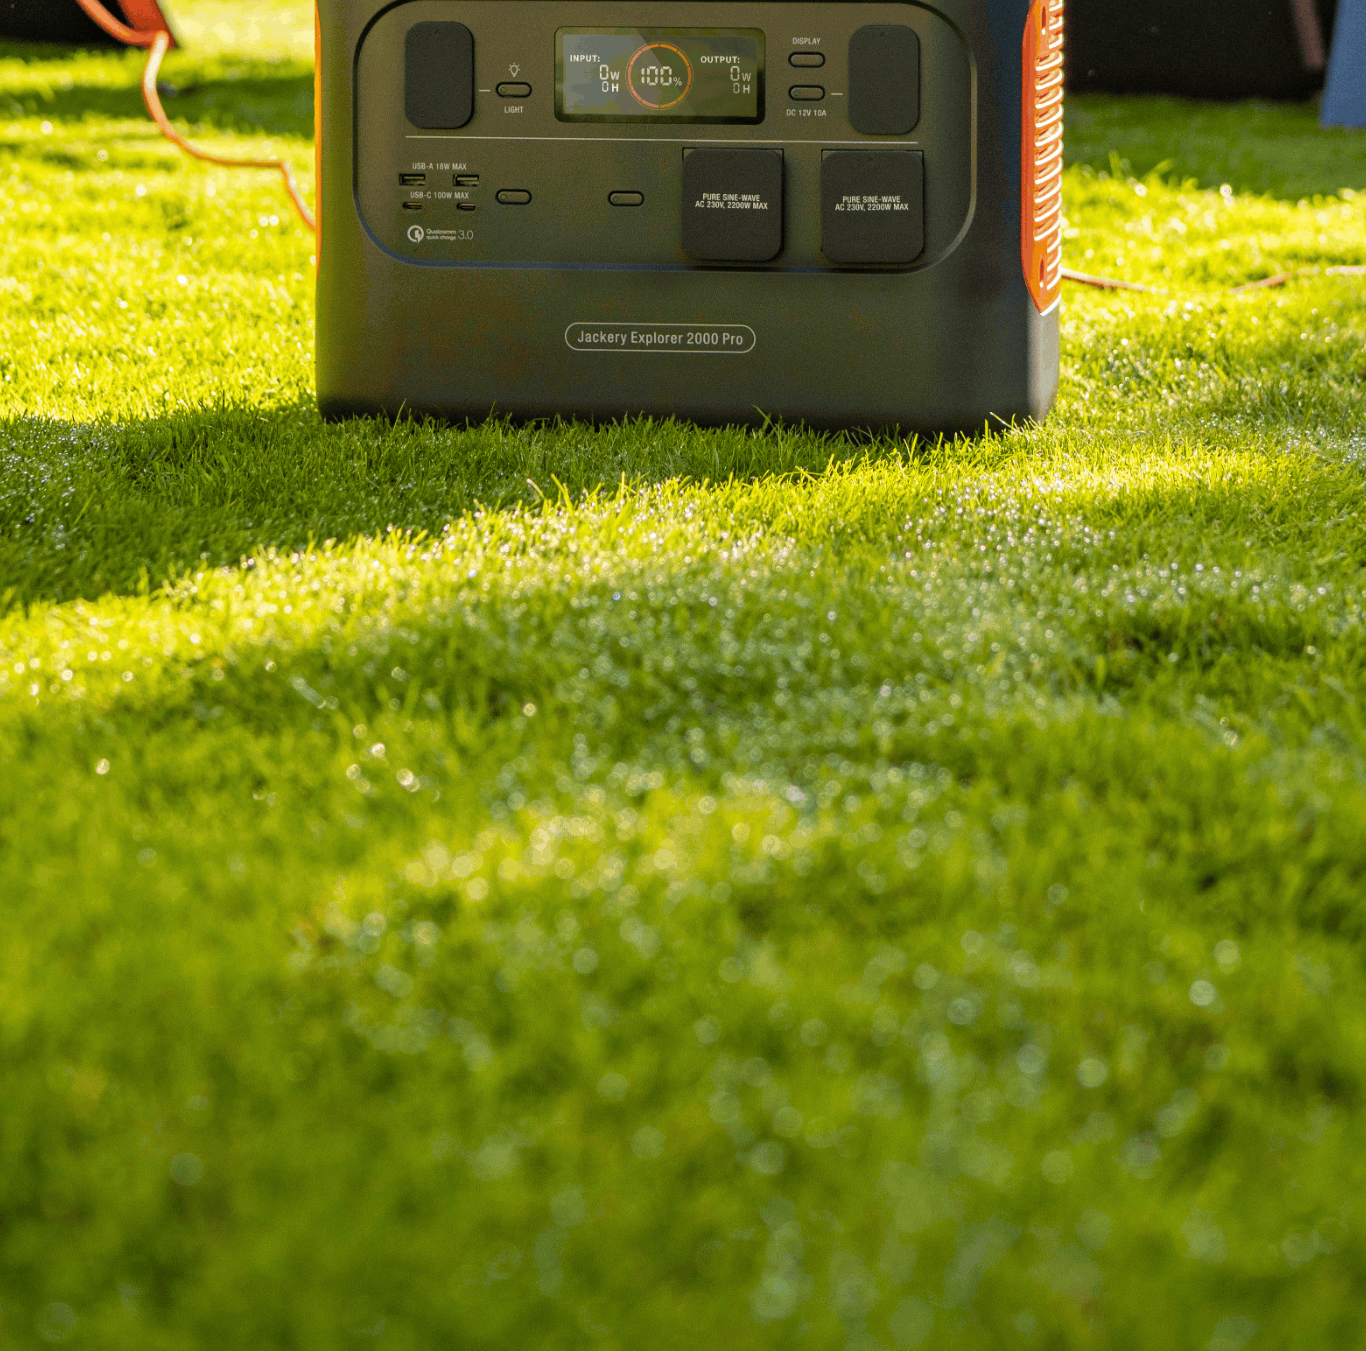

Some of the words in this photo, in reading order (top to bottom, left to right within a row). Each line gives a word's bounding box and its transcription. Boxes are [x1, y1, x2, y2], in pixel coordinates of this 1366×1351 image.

[792, 37, 821, 45] DISPLAY
[569, 54, 601, 63] INPUT:
[700, 56, 740, 64] OUTPUT:
[504, 106, 524, 114] LIGHT
[786, 108, 796, 117] DC
[798, 109, 811, 117] 12V
[814, 109, 827, 117] 10A
[412, 162, 434, 170] USB-A
[452, 163, 467, 171] MAX
[410, 191, 432, 199] USB-C
[434, 191, 452, 199] 100W
[454, 191, 469, 199] MAX
[702, 193, 720, 201] PURE
[722, 193, 761, 202] SINE-WAVE
[842, 195, 861, 204] PURE
[862, 195, 901, 204] SINE-WAVE
[695, 201, 705, 209] AC
[706, 201, 725, 210] 230V,
[727, 202, 751, 210] 2200W
[752, 202, 768, 210] MAX
[835, 203, 845, 211] AC
[846, 203, 865, 212] 230V,
[867, 203, 891, 211] 2200W
[893, 203, 909, 211] MAX
[457, 230, 474, 240] 3.0
[577, 331, 627, 346] Jackery
[630, 331, 683, 346] Explorer
[686, 332, 719, 345] 2000
[722, 332, 743, 345] Pro
